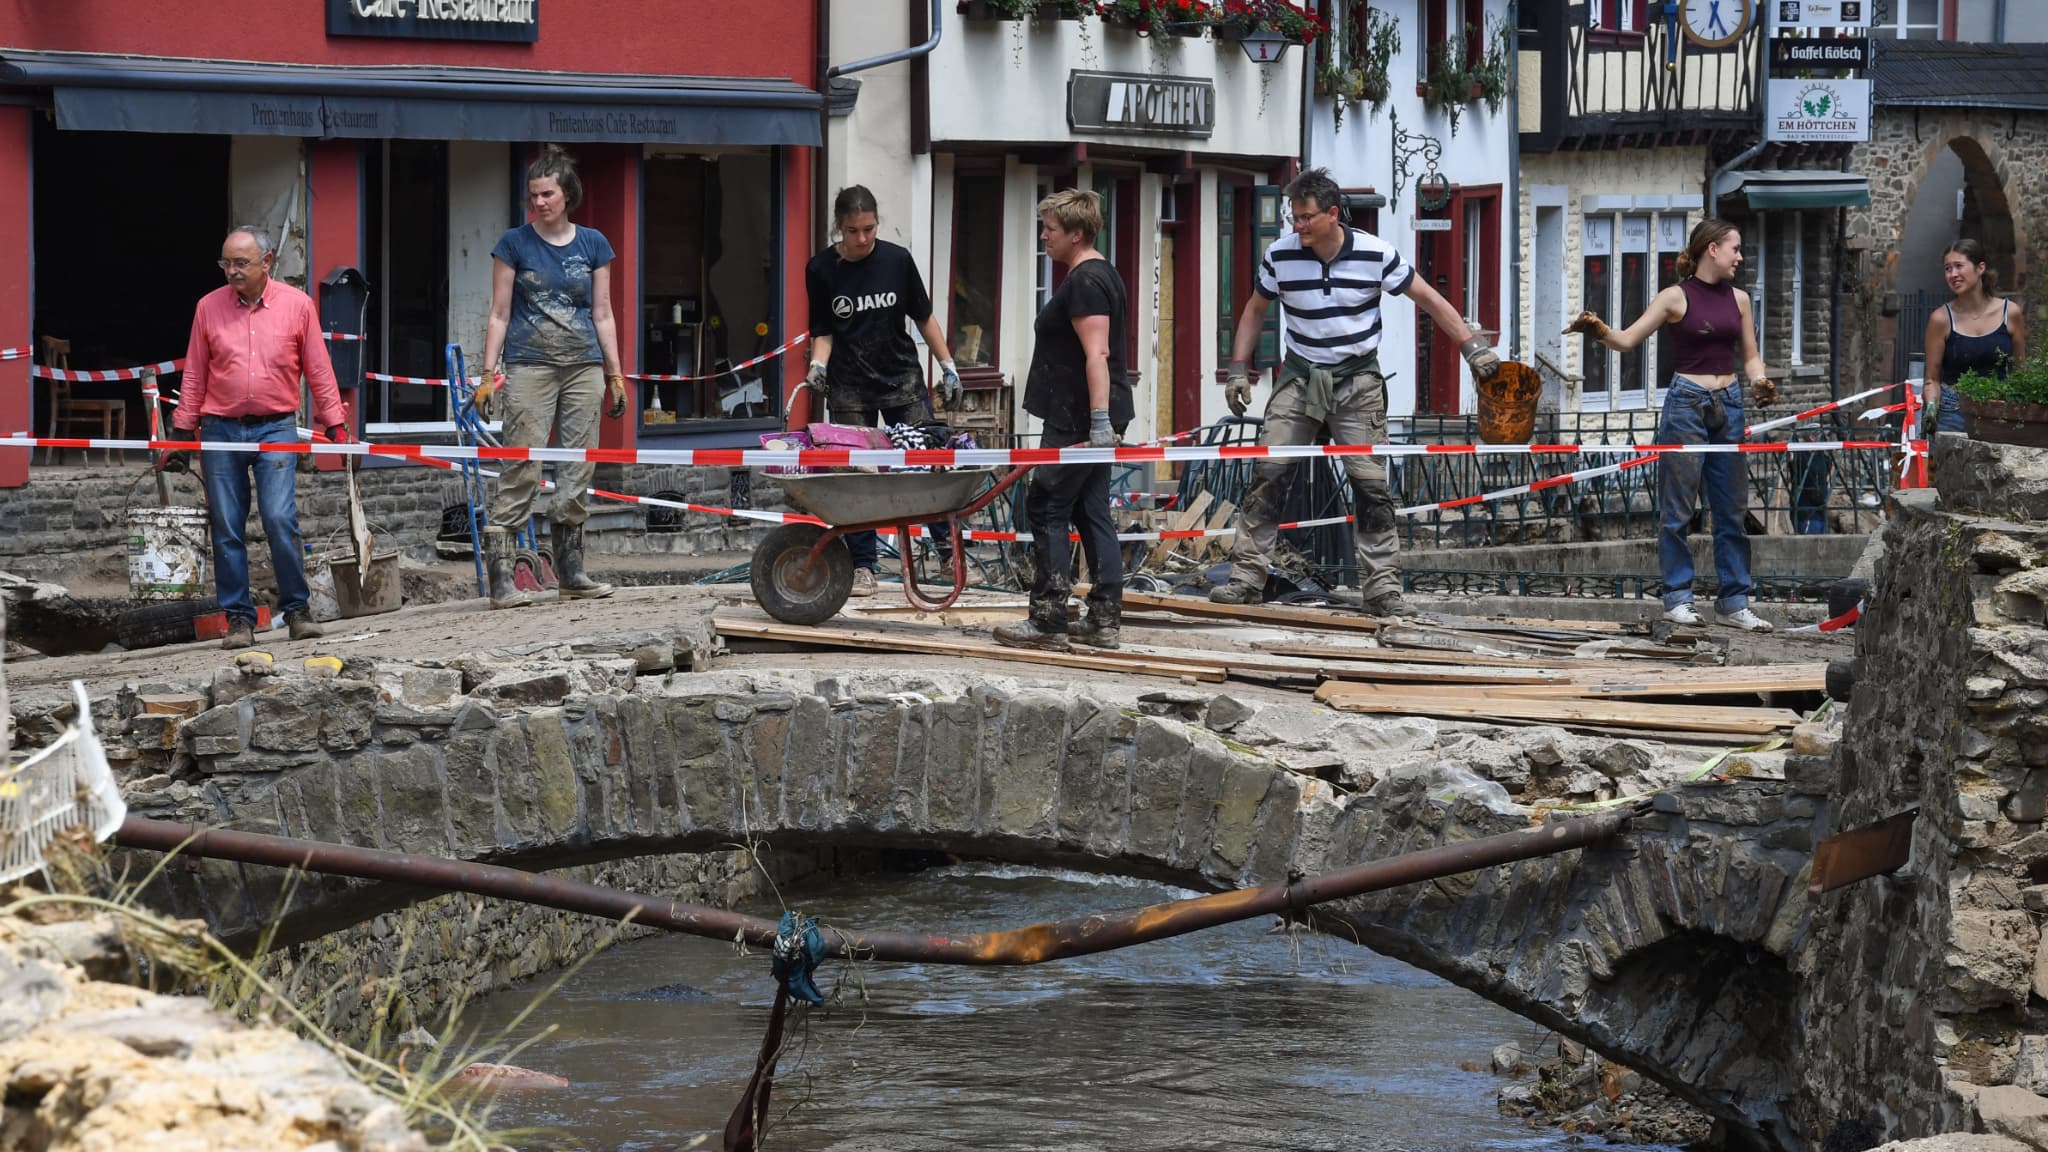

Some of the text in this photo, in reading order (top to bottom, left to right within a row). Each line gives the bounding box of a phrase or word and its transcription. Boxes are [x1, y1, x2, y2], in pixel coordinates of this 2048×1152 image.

[1791, 46, 1861, 60] Gaffel Kölsch
[549, 111, 604, 134] Printenhaus
[1779, 119, 1856, 130] EM HÖTTCHEN
[856, 292, 897, 312] JAKO
